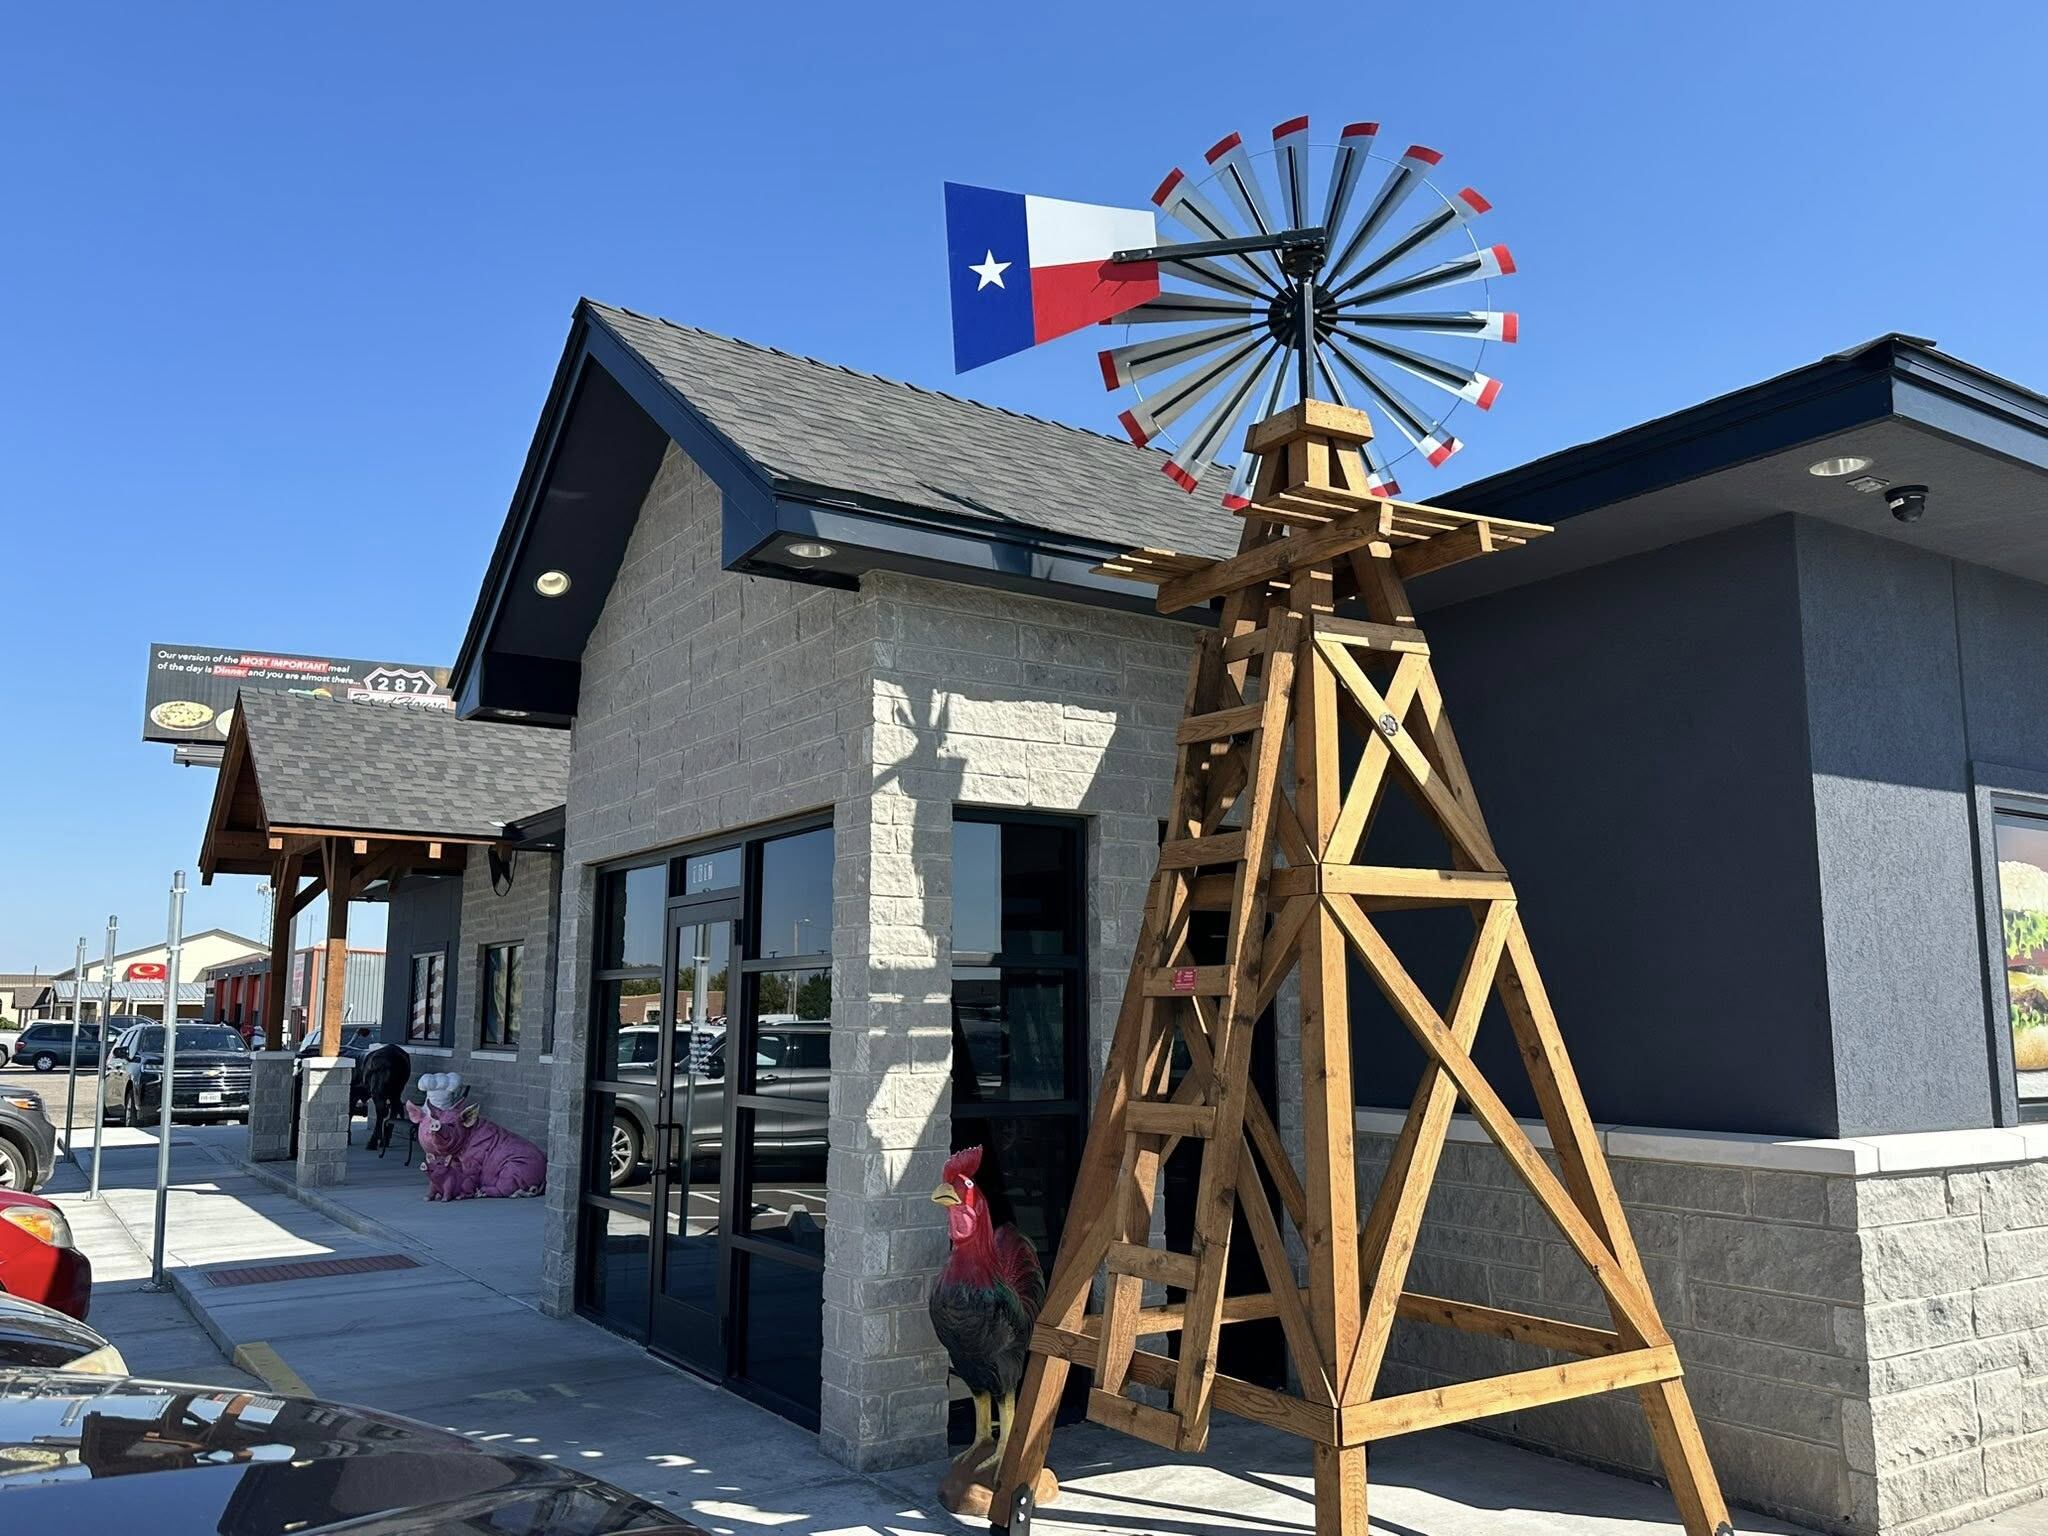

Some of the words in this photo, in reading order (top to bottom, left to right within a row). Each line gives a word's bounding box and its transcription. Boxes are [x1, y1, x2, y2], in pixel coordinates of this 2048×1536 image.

[158, 650, 176, 659] Our
[178, 653, 210, 662] version
[212, 654, 224, 663] of
[224, 655, 239, 664] the
[239, 656, 269, 666] MOST
[270, 659, 329, 671] IMPORTANT
[328, 665, 350, 673] meal
[157, 662, 169, 670] of
[169, 662, 184, 671] the
[186, 664, 203, 674] day
[213, 666, 247, 677] Dinner
[248, 669, 266, 677] and
[265, 671, 283, 679] you
[300, 673, 330, 682] almost
[331, 675, 361, 685] there...
